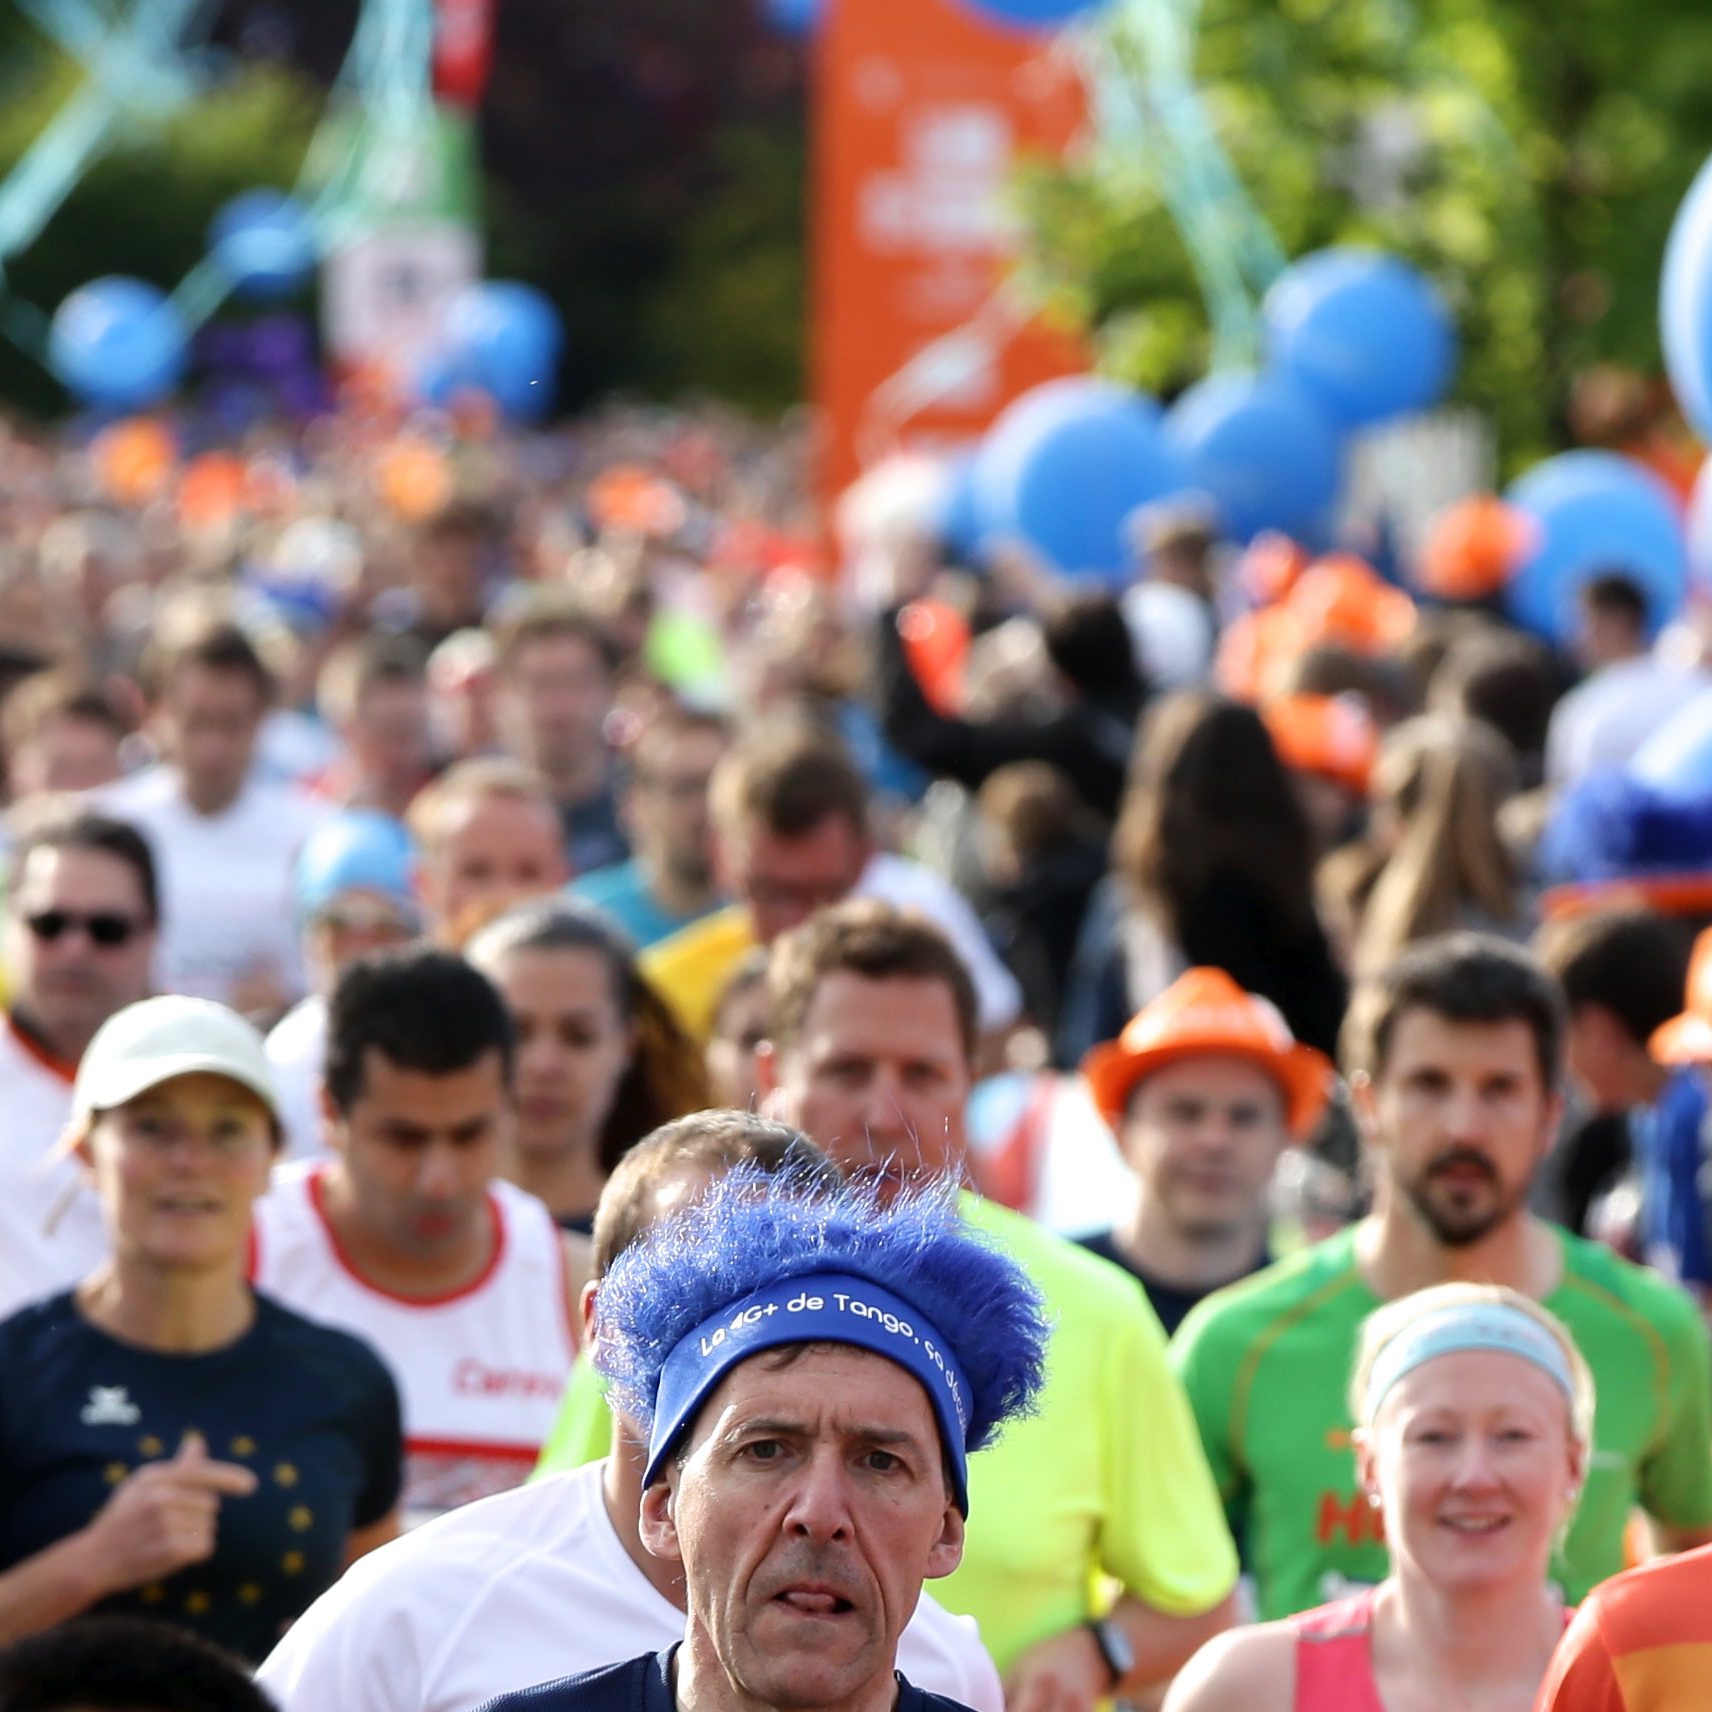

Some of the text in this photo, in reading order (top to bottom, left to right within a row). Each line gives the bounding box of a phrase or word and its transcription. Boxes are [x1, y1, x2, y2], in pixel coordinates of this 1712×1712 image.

[701, 1327, 726, 1357] La
[786, 1292, 824, 1312] de
[832, 1293, 920, 1345] Tango,
